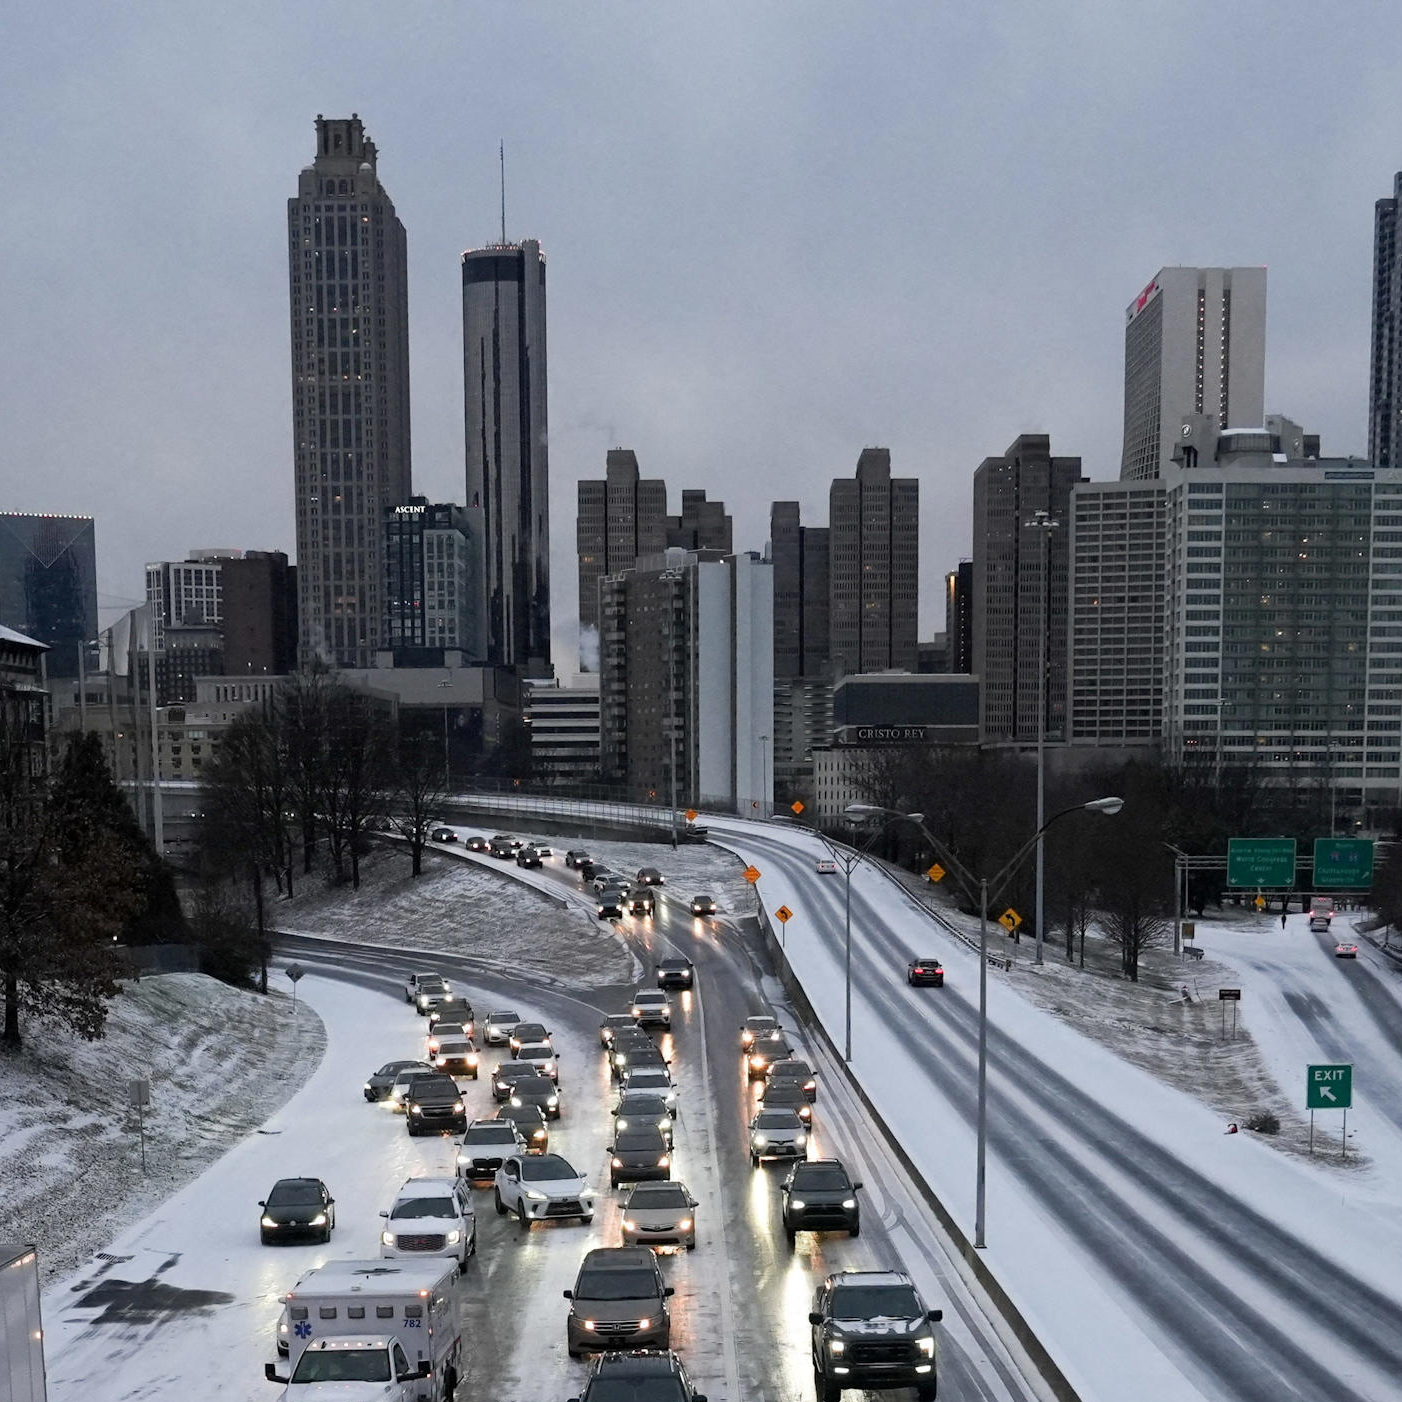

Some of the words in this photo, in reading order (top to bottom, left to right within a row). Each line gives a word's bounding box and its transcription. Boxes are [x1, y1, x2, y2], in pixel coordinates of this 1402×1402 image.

[394, 505, 426, 514] ASCENT
[858, 728, 900, 739] CRISTO
[904, 728, 925, 738] REY
[1314, 1070, 1345, 1081] EXIT
[402, 1319, 422, 1328] 782
